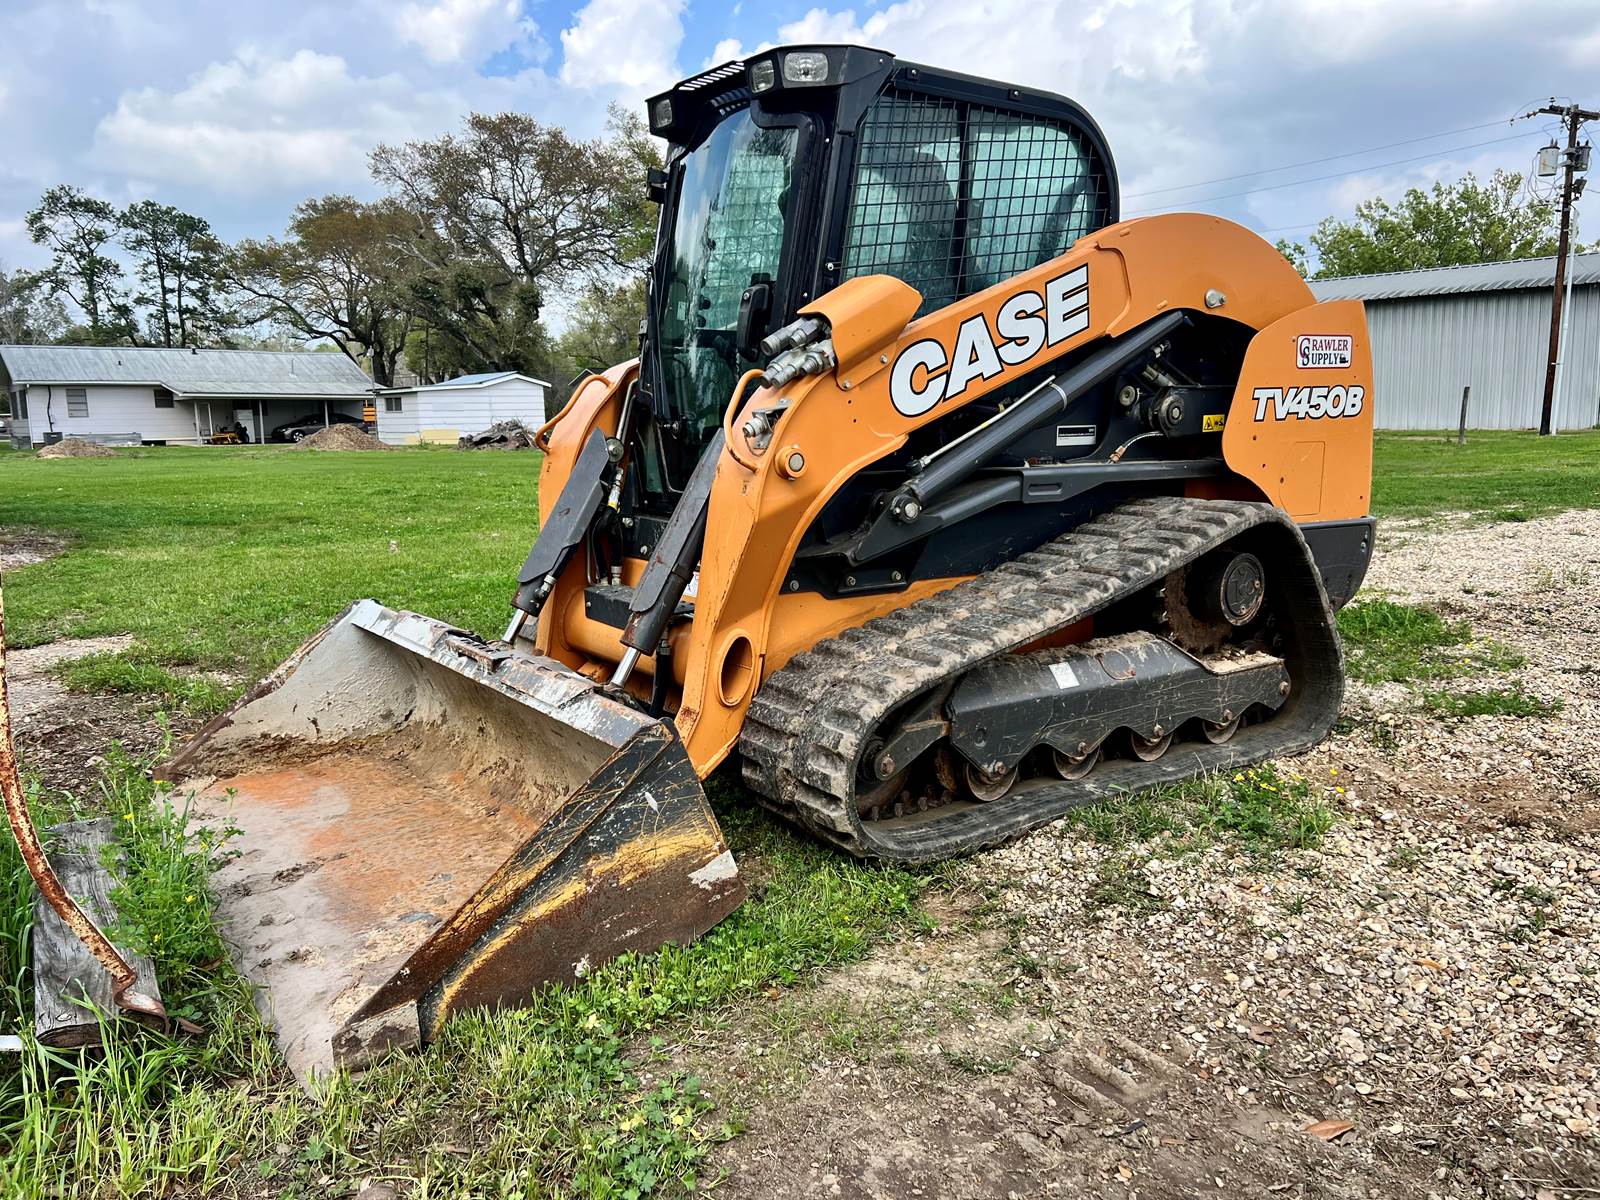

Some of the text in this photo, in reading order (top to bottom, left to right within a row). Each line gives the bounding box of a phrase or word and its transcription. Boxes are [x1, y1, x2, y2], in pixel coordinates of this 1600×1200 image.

[889, 262, 1090, 418] CASE
[1300, 338, 1348, 356] CRAWLER
[1302, 349, 1339, 366] SUPPLY
[1252, 385, 1365, 422] TV450B
